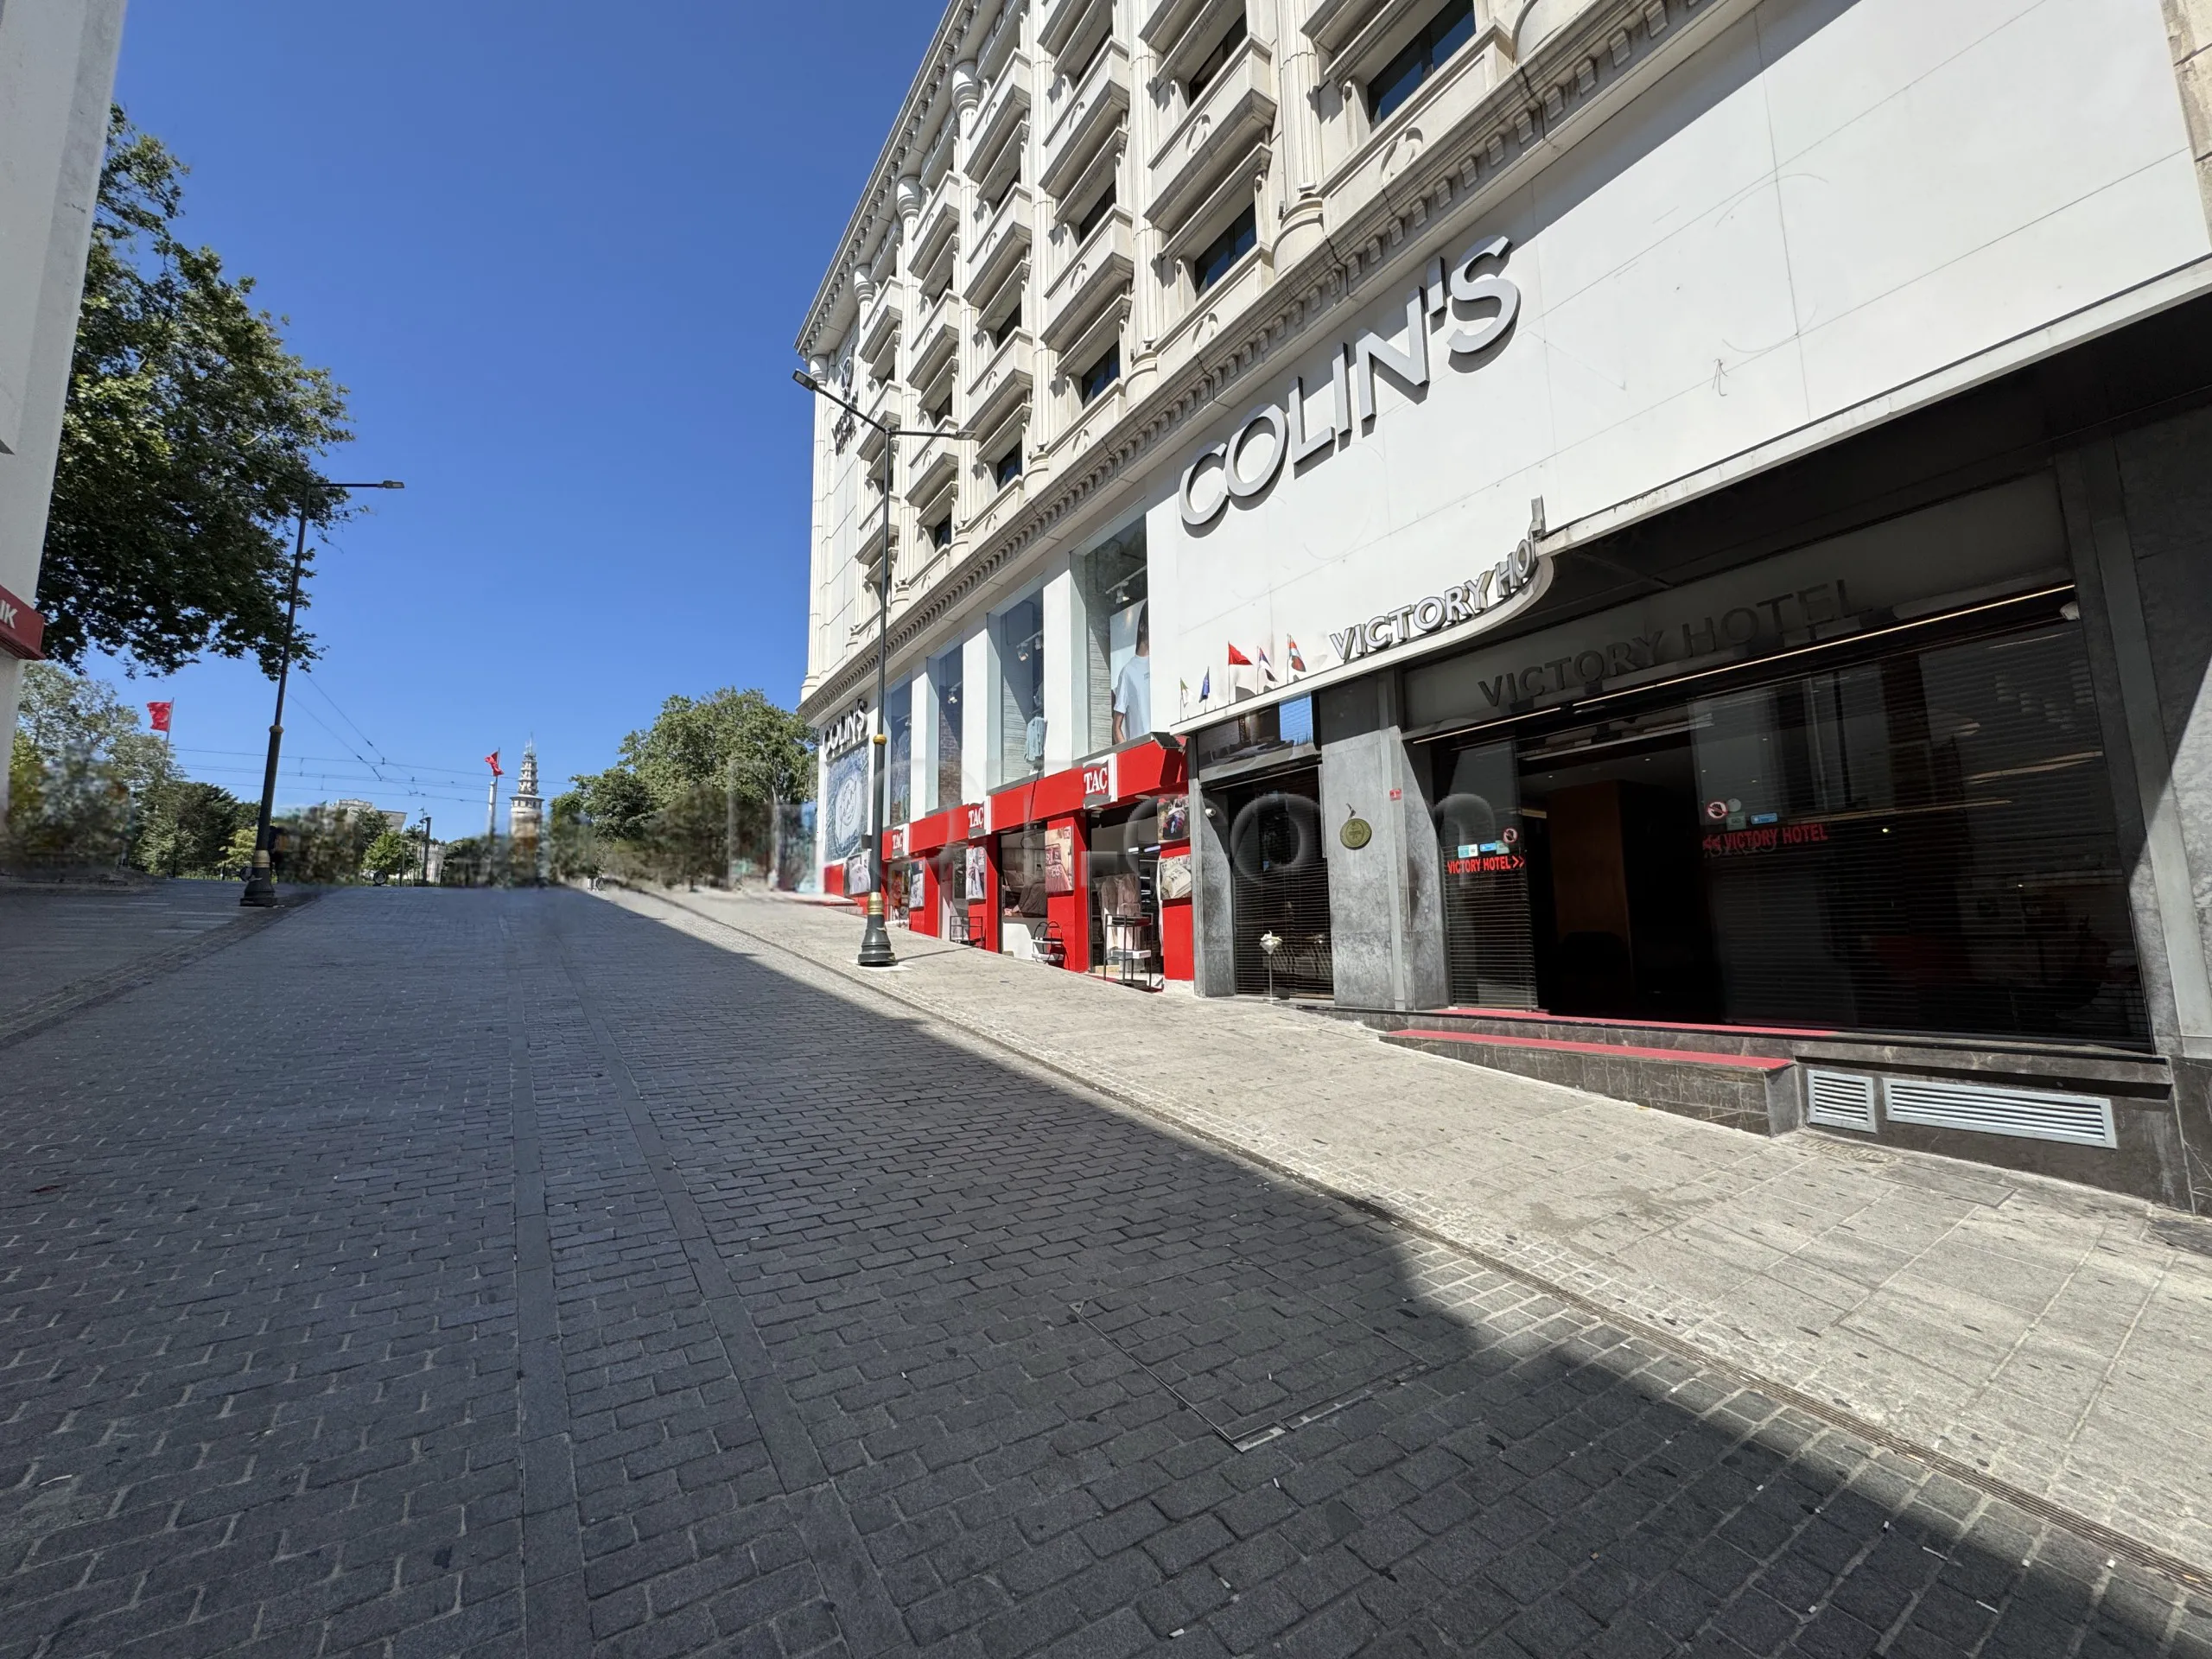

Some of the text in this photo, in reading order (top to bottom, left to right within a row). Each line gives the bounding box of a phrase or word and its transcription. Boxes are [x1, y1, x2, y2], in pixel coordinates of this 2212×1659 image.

[1178, 235, 1521, 526] COLIN'S
[1329, 569, 1495, 661] VICTORY
[1478, 578, 1872, 708] VICTORY HOTEL
[823, 699, 868, 755] COLIN'S
[1083, 766, 1108, 795] TAÇ
[968, 806, 984, 829] TAÇ
[1724, 829, 1778, 850] VICTORY
[1783, 824, 1828, 844] HOTEL
[1446, 855, 1511, 874] VICTORY HOTEL
